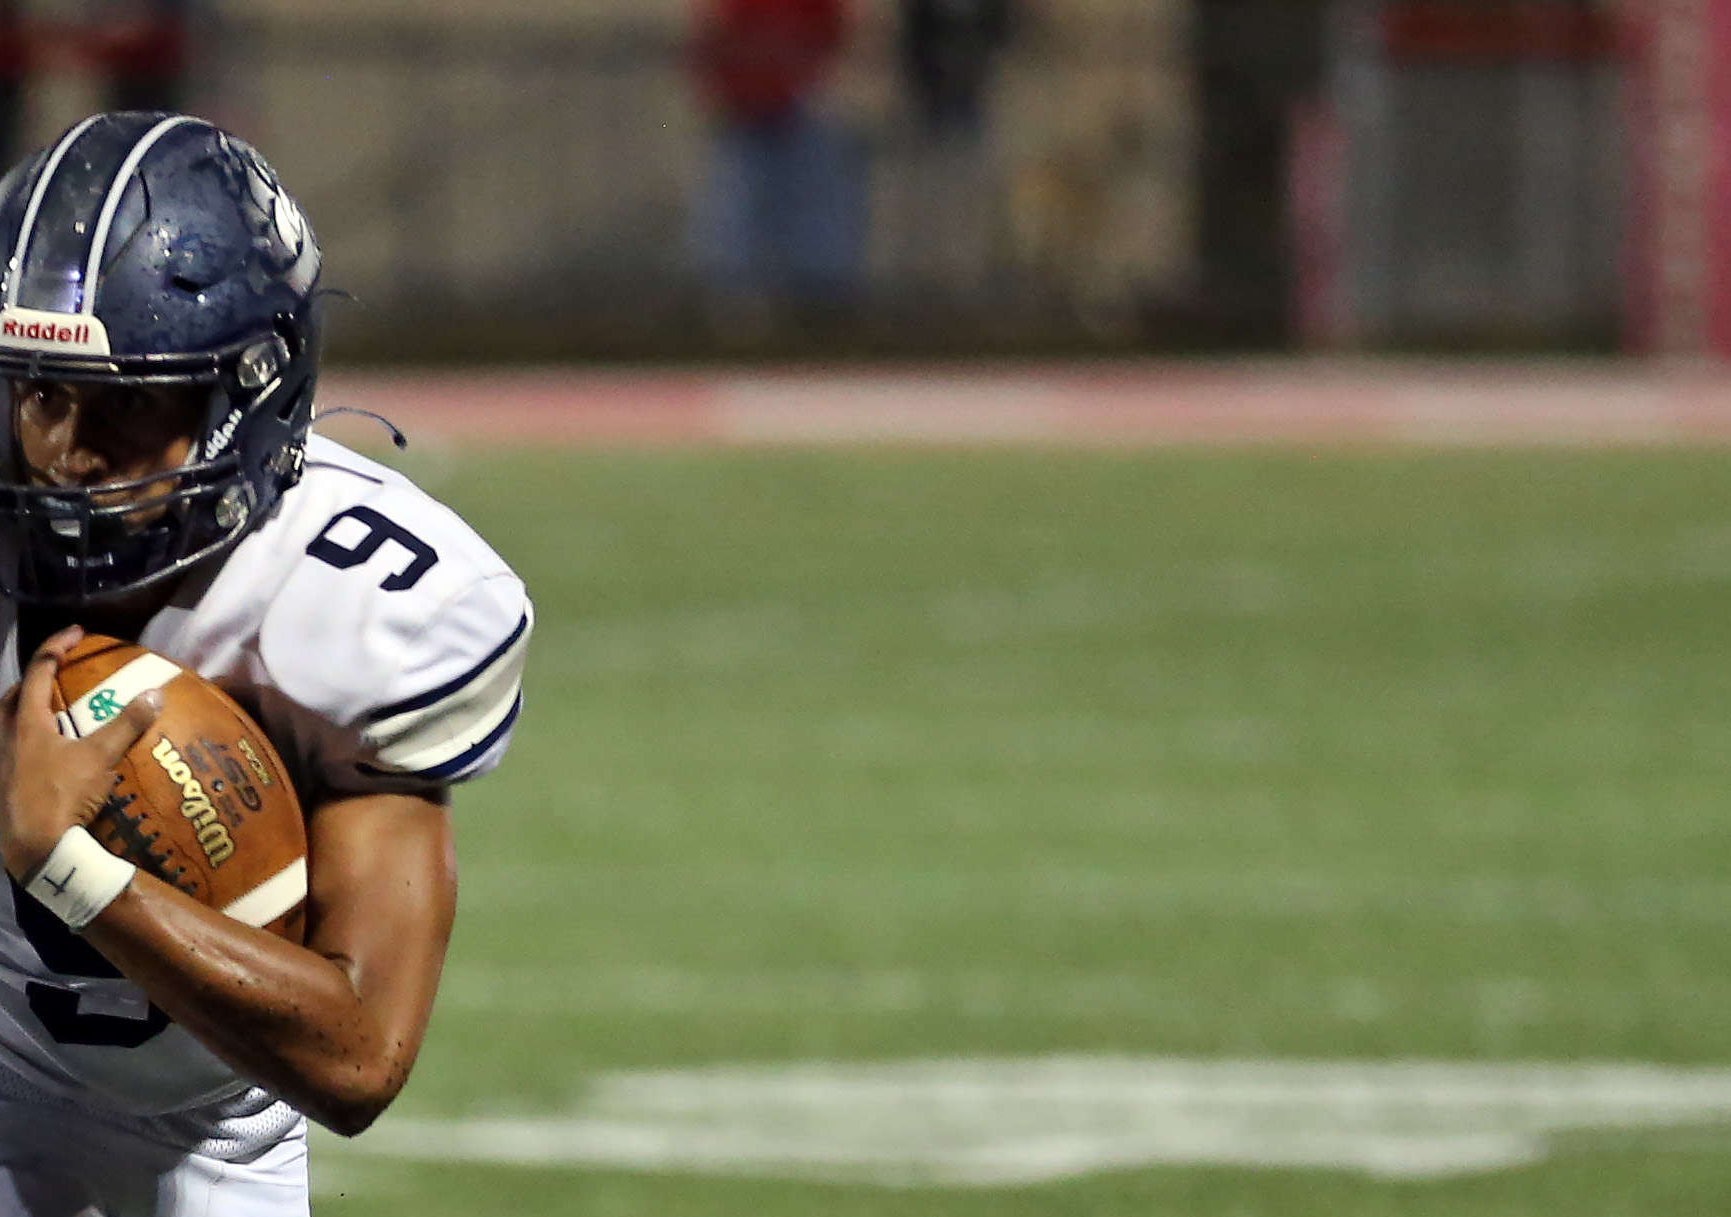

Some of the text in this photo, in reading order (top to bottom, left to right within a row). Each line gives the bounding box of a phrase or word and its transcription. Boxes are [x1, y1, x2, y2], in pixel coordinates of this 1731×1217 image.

[3, 320, 90, 344] Riddell
[205, 408, 243, 460] ddell
[305, 505, 439, 592] 9
[151, 737, 235, 869] Wilson
